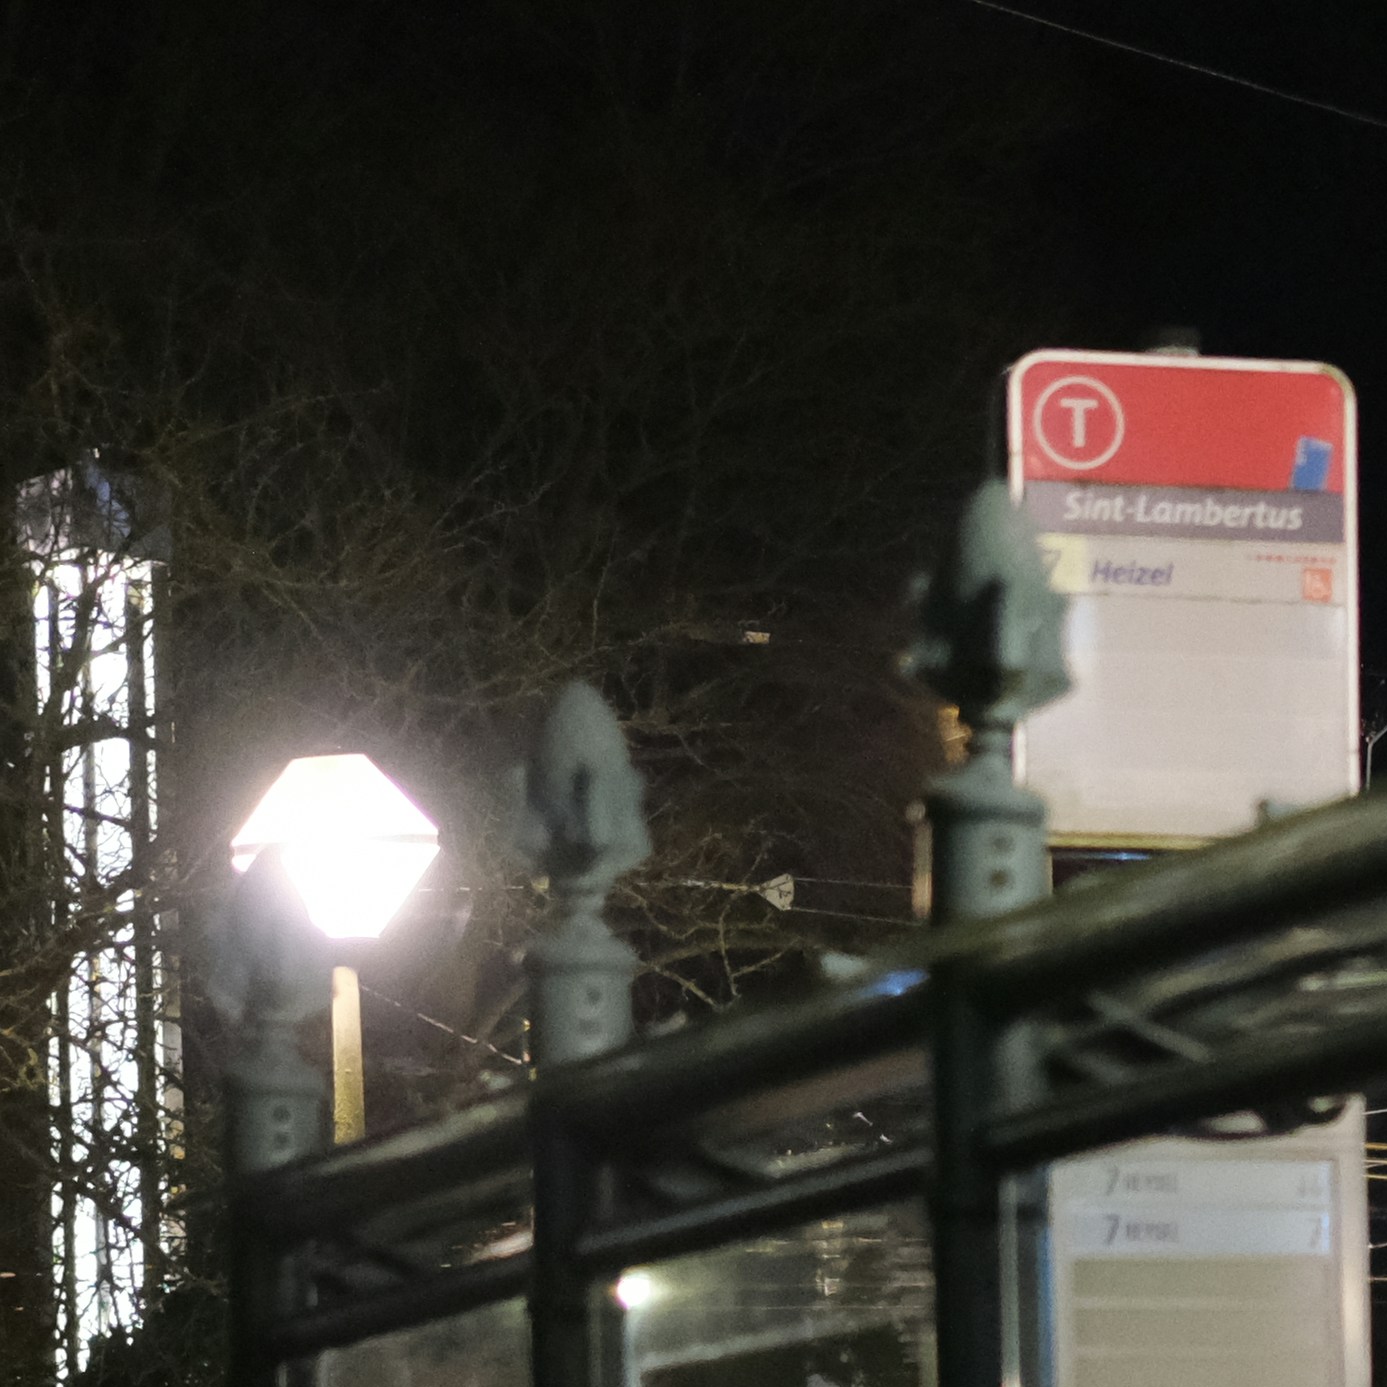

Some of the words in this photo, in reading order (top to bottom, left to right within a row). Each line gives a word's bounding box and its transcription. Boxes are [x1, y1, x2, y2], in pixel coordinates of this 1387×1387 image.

[1060, 398, 1099, 449] T
[1063, 490, 1303, 531] Sint-Lambertus
[1090, 560, 1174, 587] Heizel
